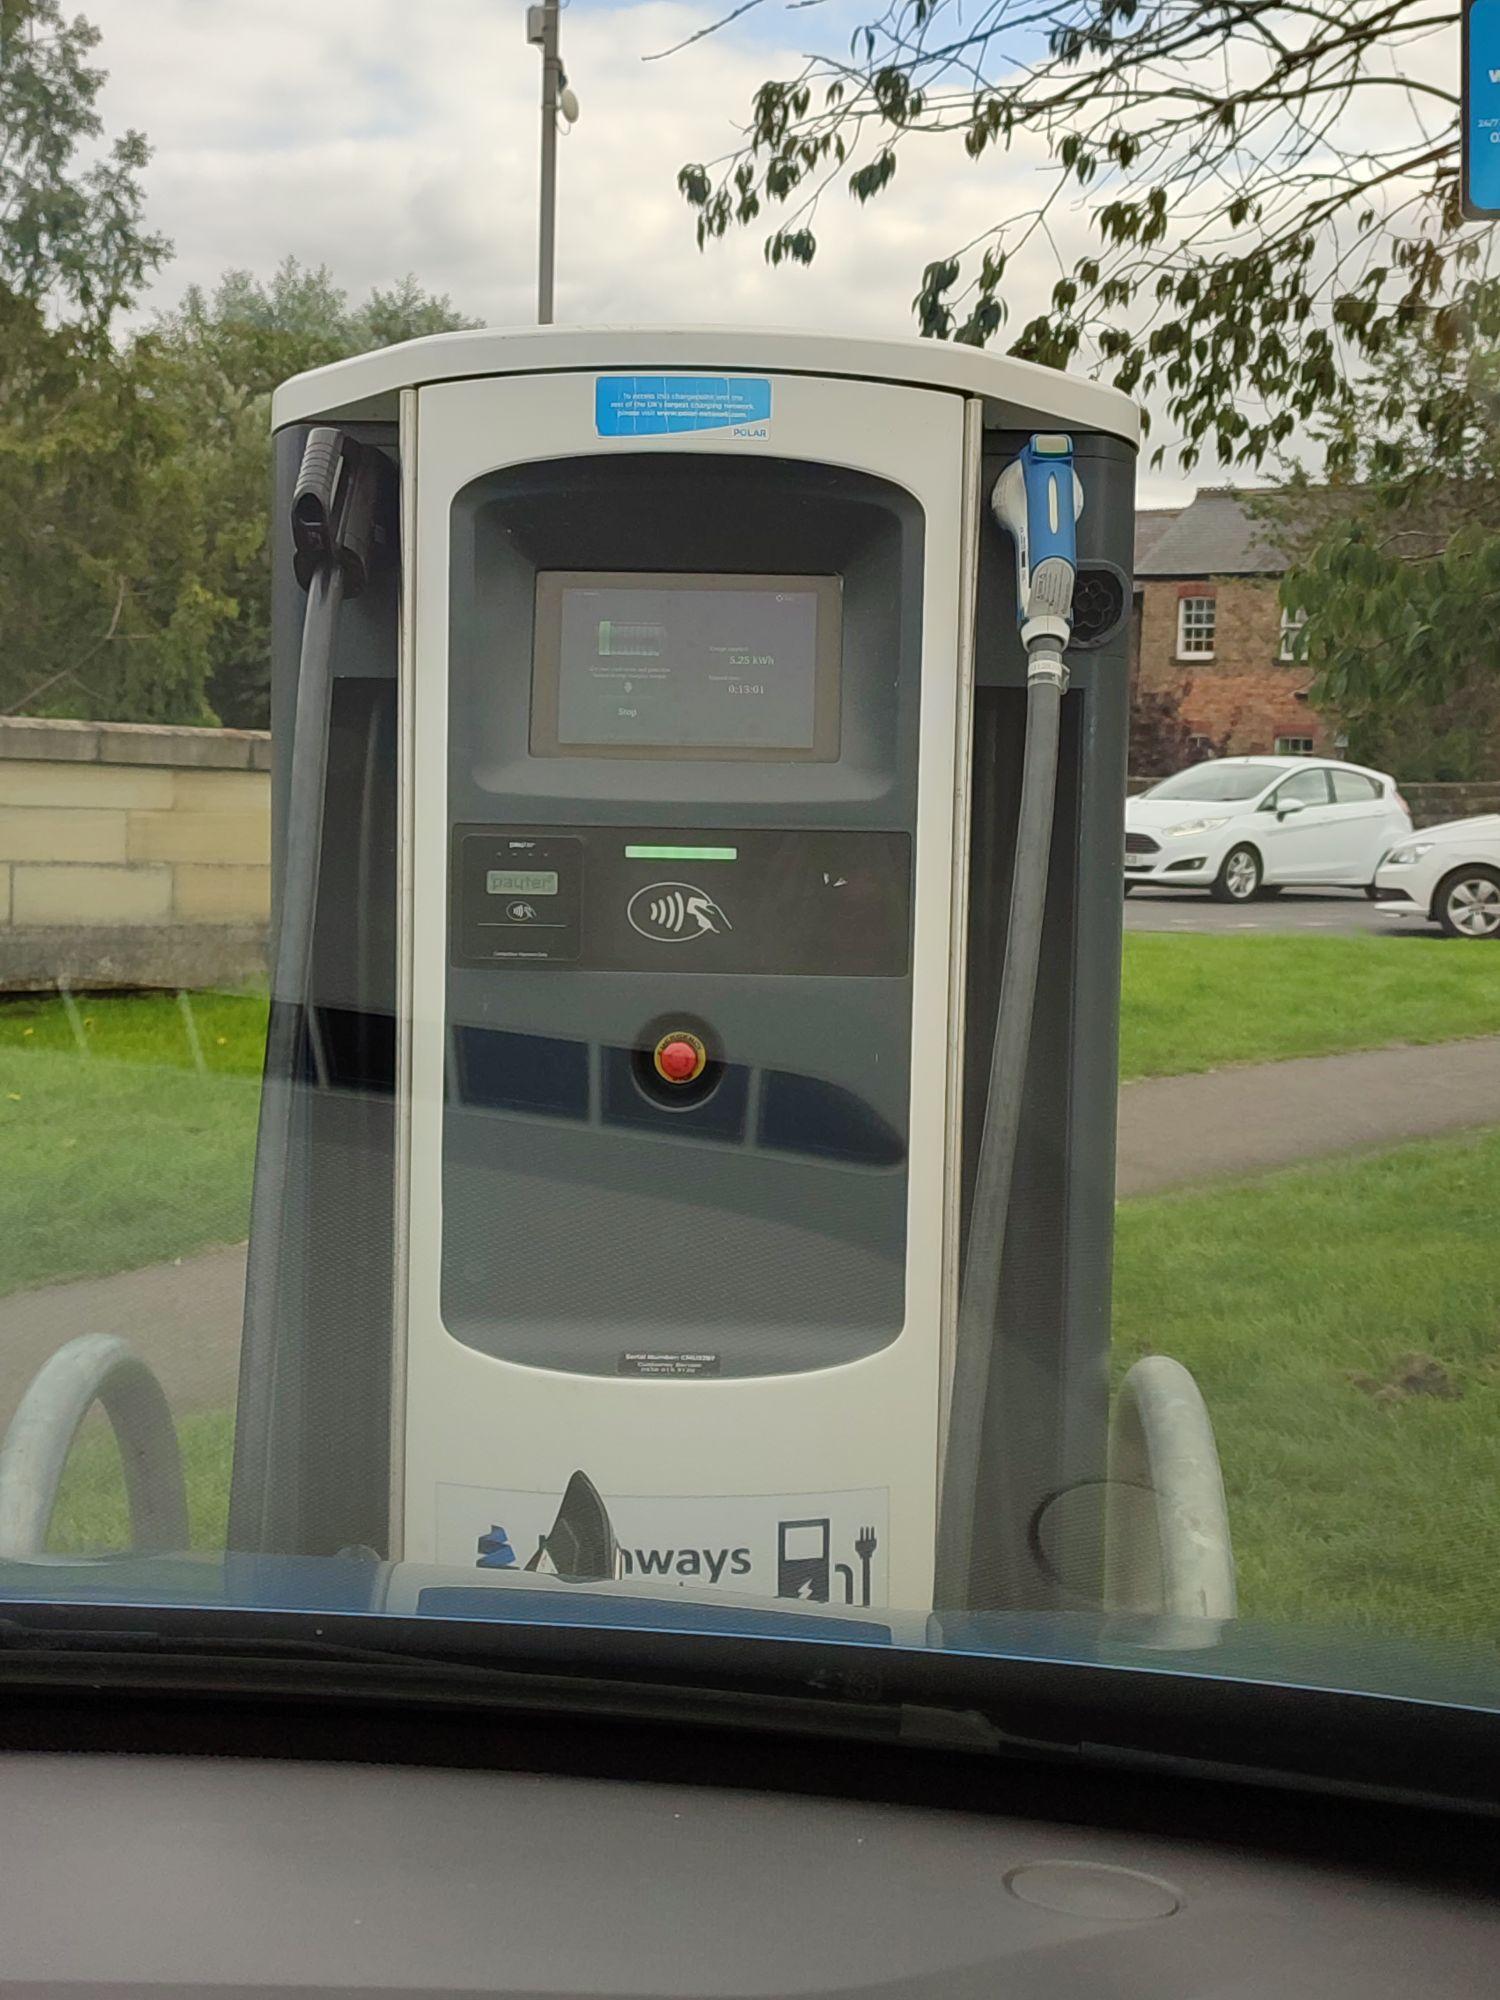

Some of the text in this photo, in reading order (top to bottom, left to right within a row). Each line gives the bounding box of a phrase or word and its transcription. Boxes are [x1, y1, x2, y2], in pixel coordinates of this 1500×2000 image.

[733, 429, 766, 438] POLAR
[729, 655, 775, 666] 5.25 kWh
[618, 707, 638, 717] Stop
[494, 876, 551, 891] payter
